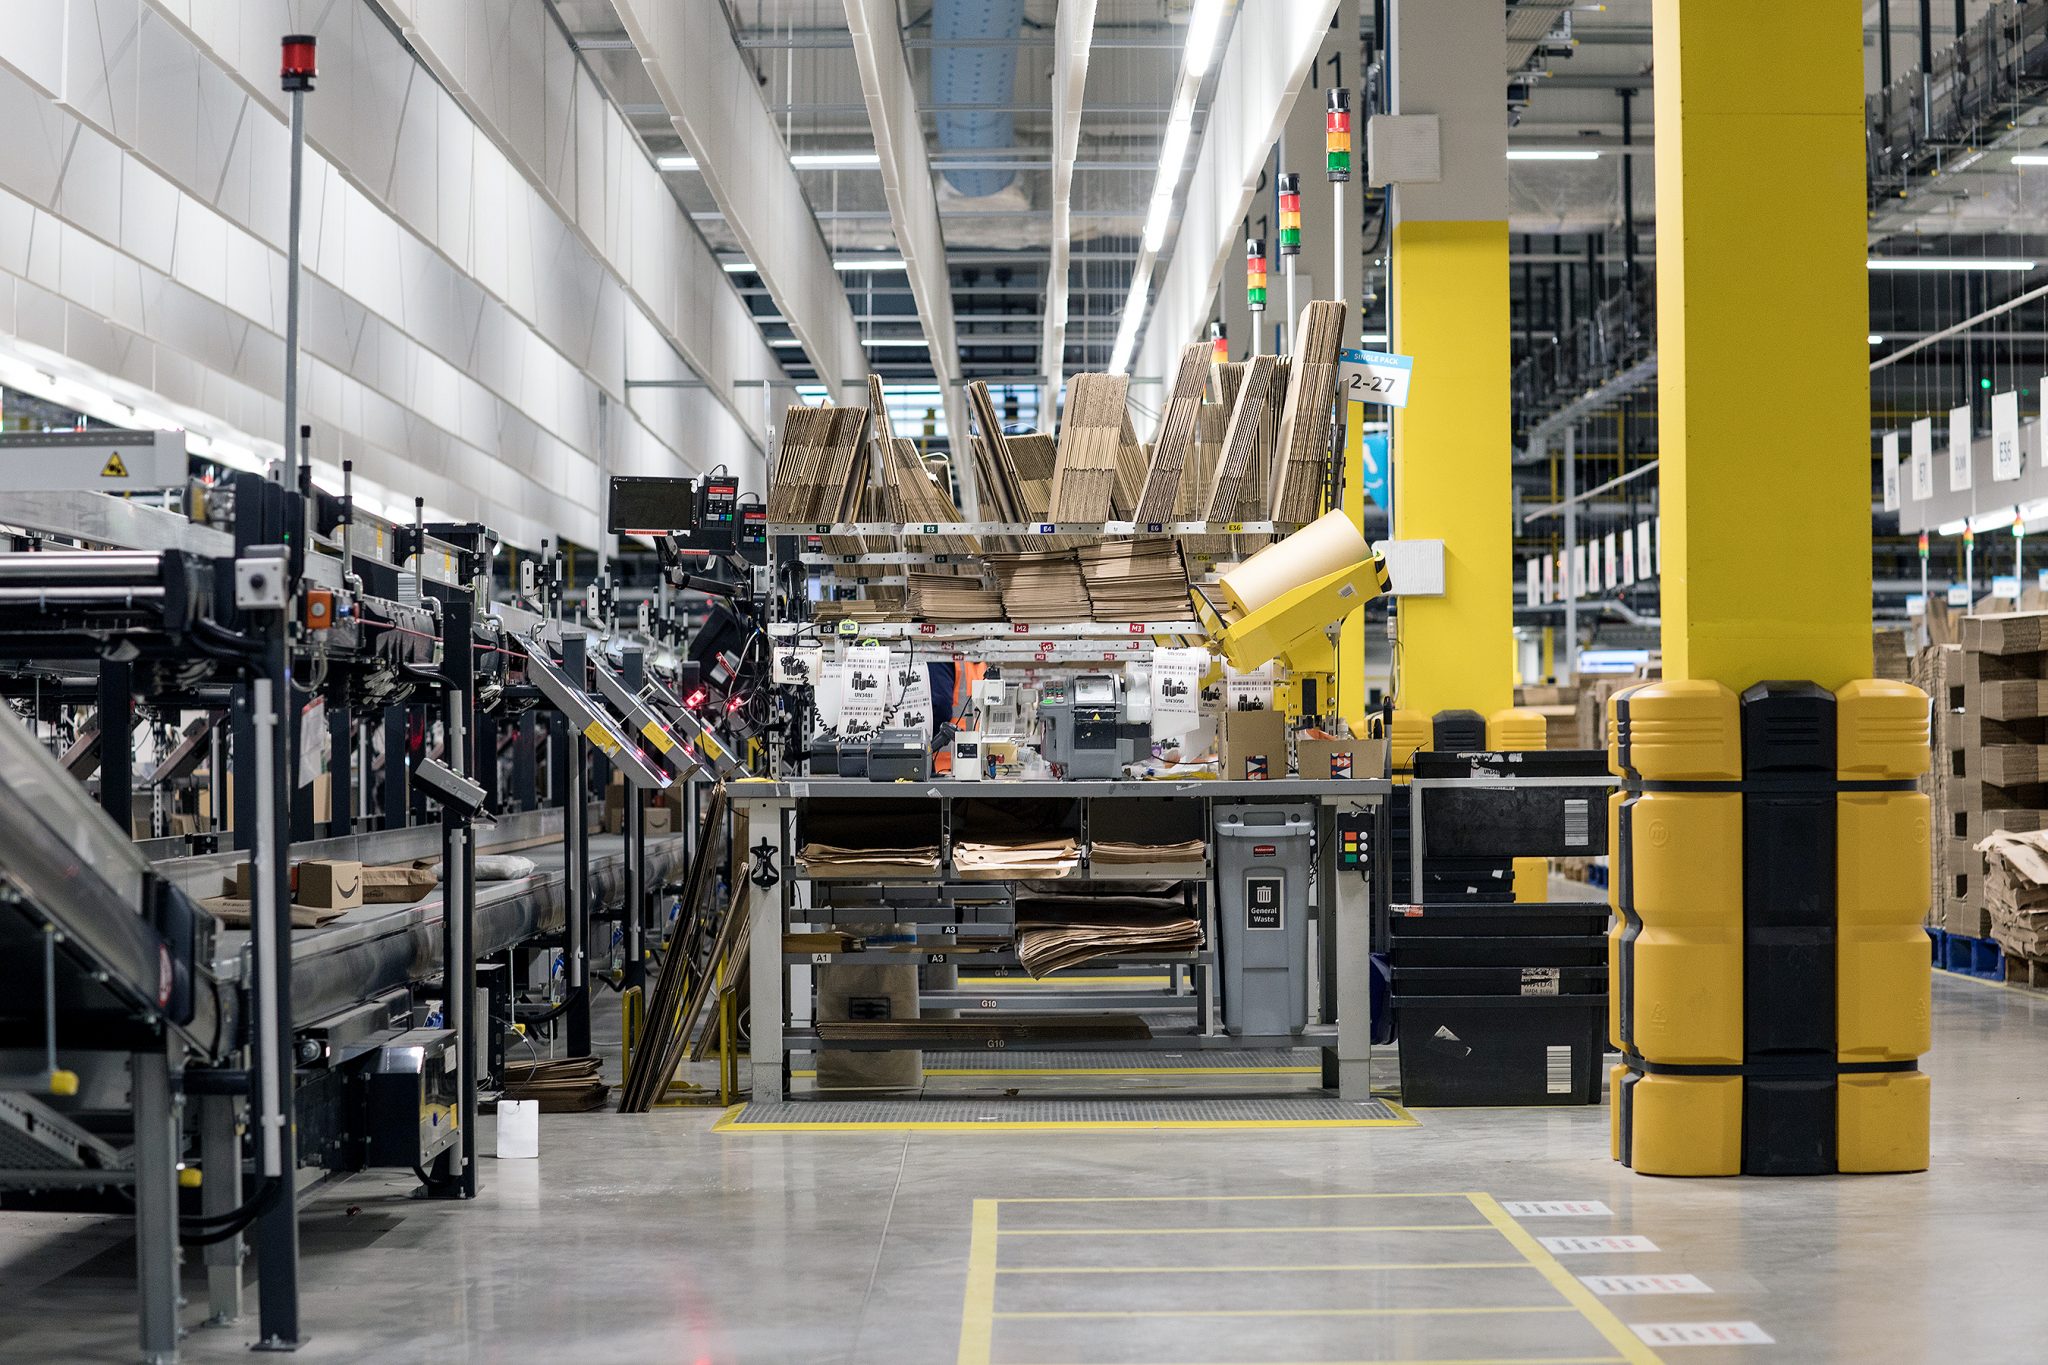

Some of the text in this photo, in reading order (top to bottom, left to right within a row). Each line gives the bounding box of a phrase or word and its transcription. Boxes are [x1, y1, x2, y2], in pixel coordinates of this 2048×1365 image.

[1354, 353, 1398, 365] SINGLE PACK
[1350, 373, 1396, 393] 2-27
[1016, 625, 1027, 633] M2
[945, 926, 956, 934] A3
[816, 954, 827, 963] A1
[931, 954, 944, 963] A3
[981, 1000, 997, 1008] G10
[987, 1040, 1004, 1048] G10
